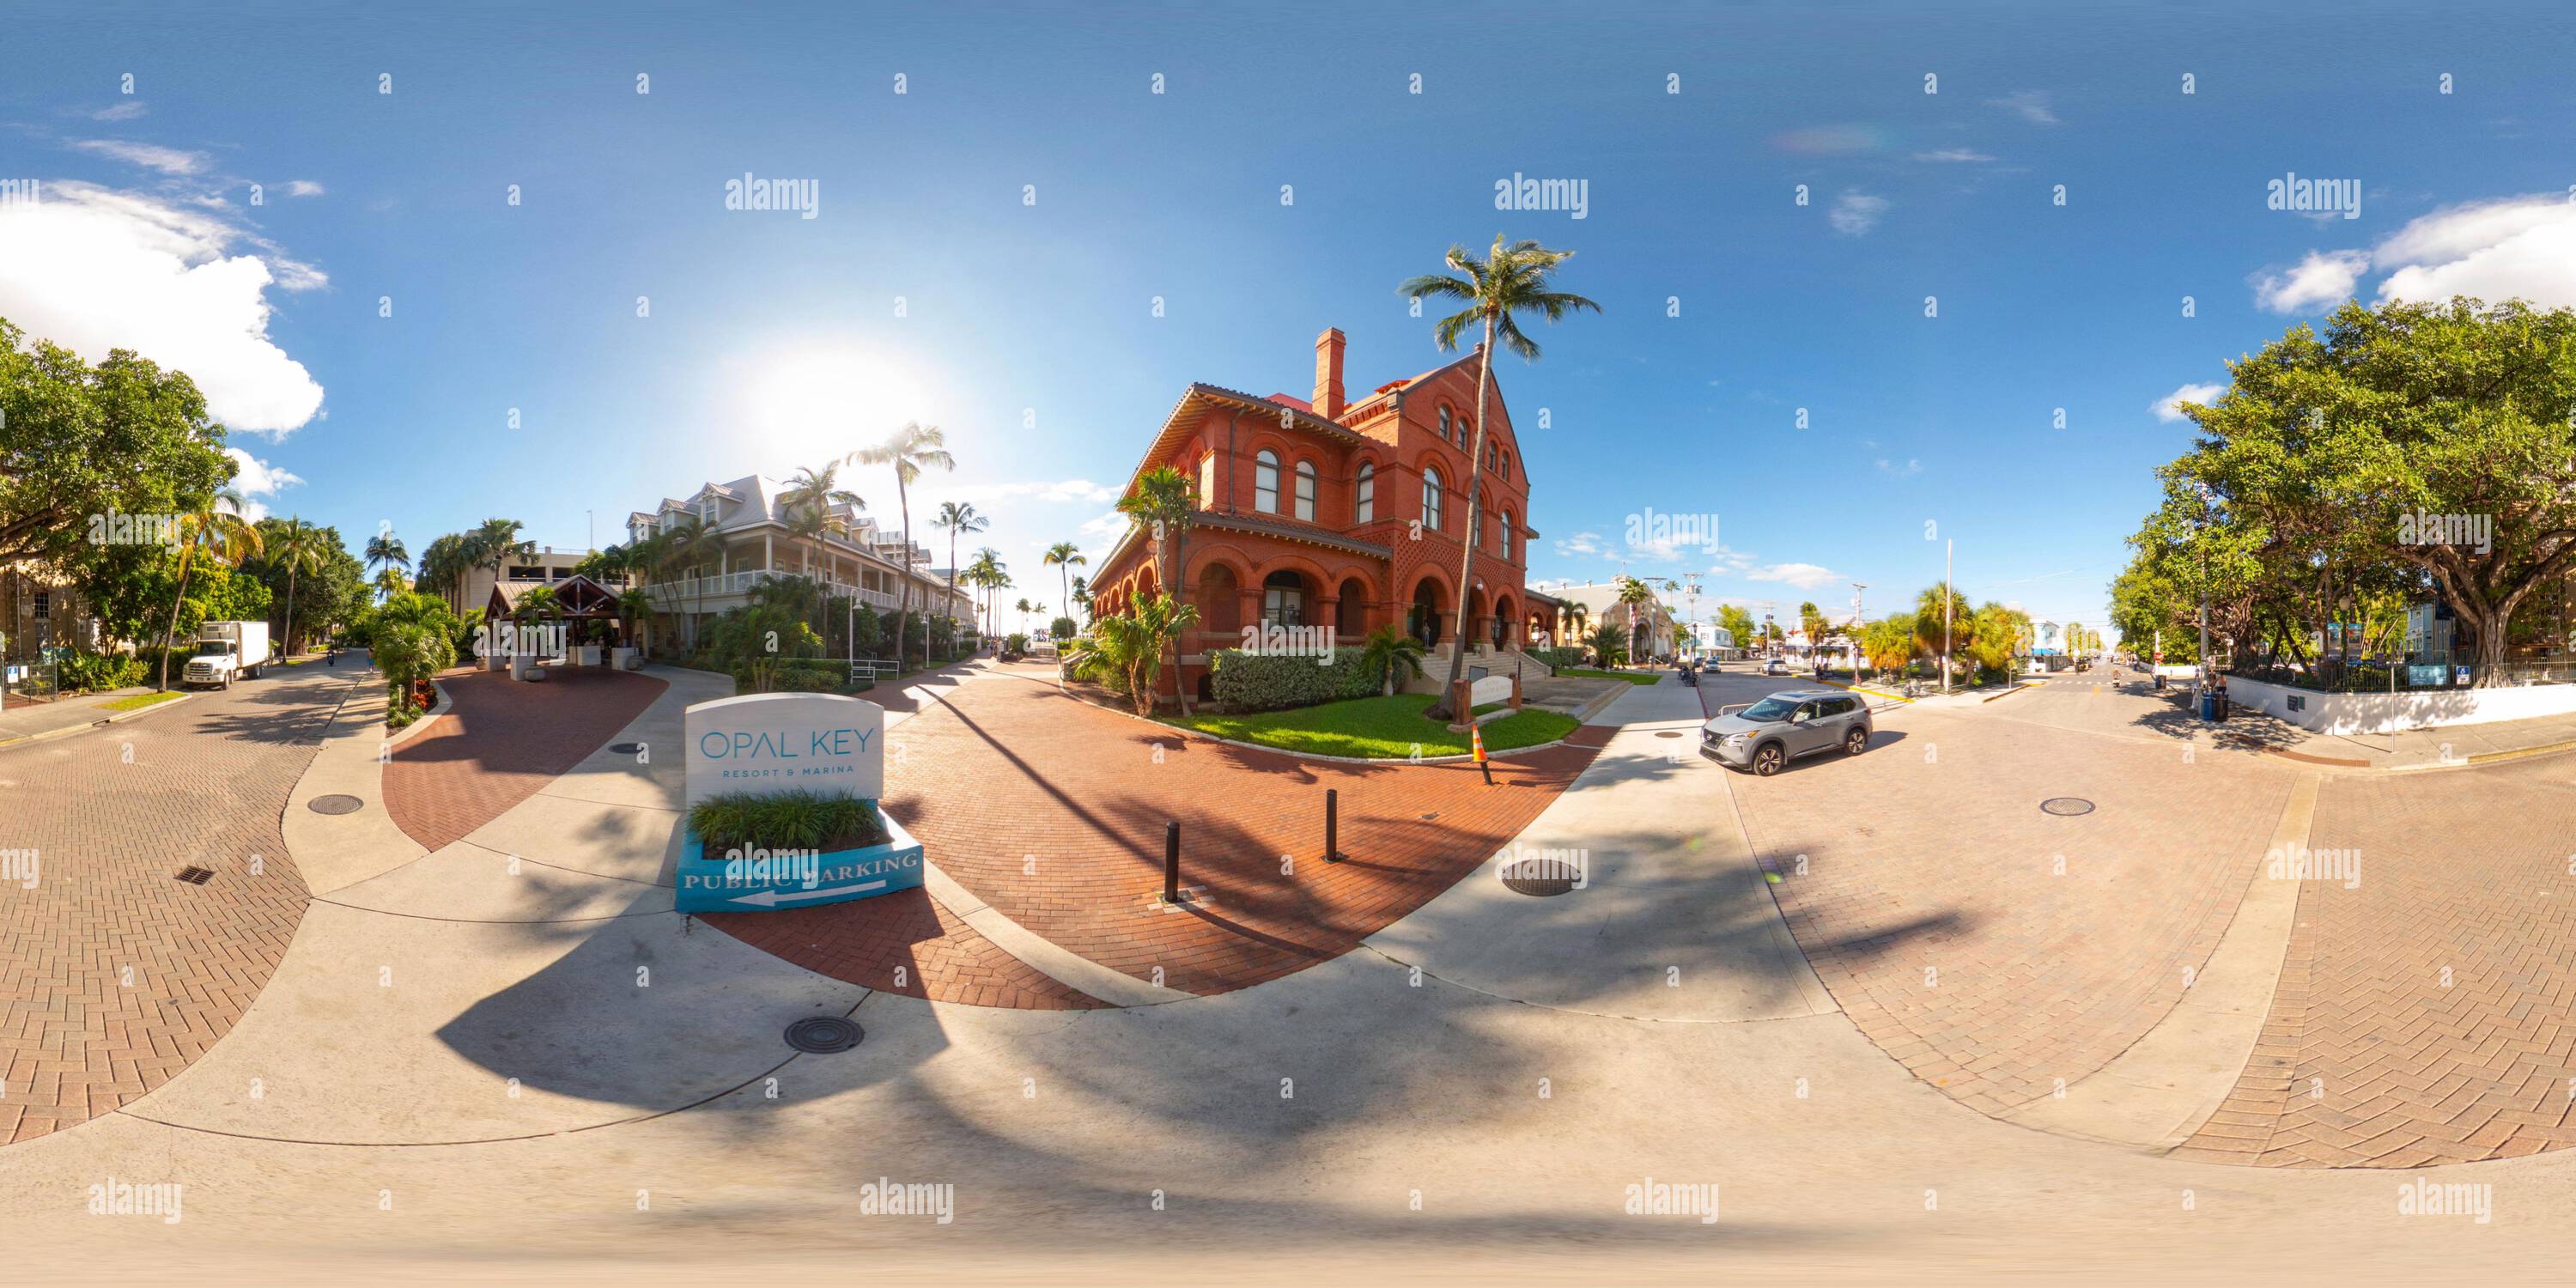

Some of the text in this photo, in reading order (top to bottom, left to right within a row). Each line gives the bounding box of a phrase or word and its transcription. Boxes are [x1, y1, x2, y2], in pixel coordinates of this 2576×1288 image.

[701, 728, 874, 758] OPAL KEY
[723, 769, 779, 778] RESORT
[803, 765, 854, 775] MARINA
[683, 873, 793, 889] PUBLIC
